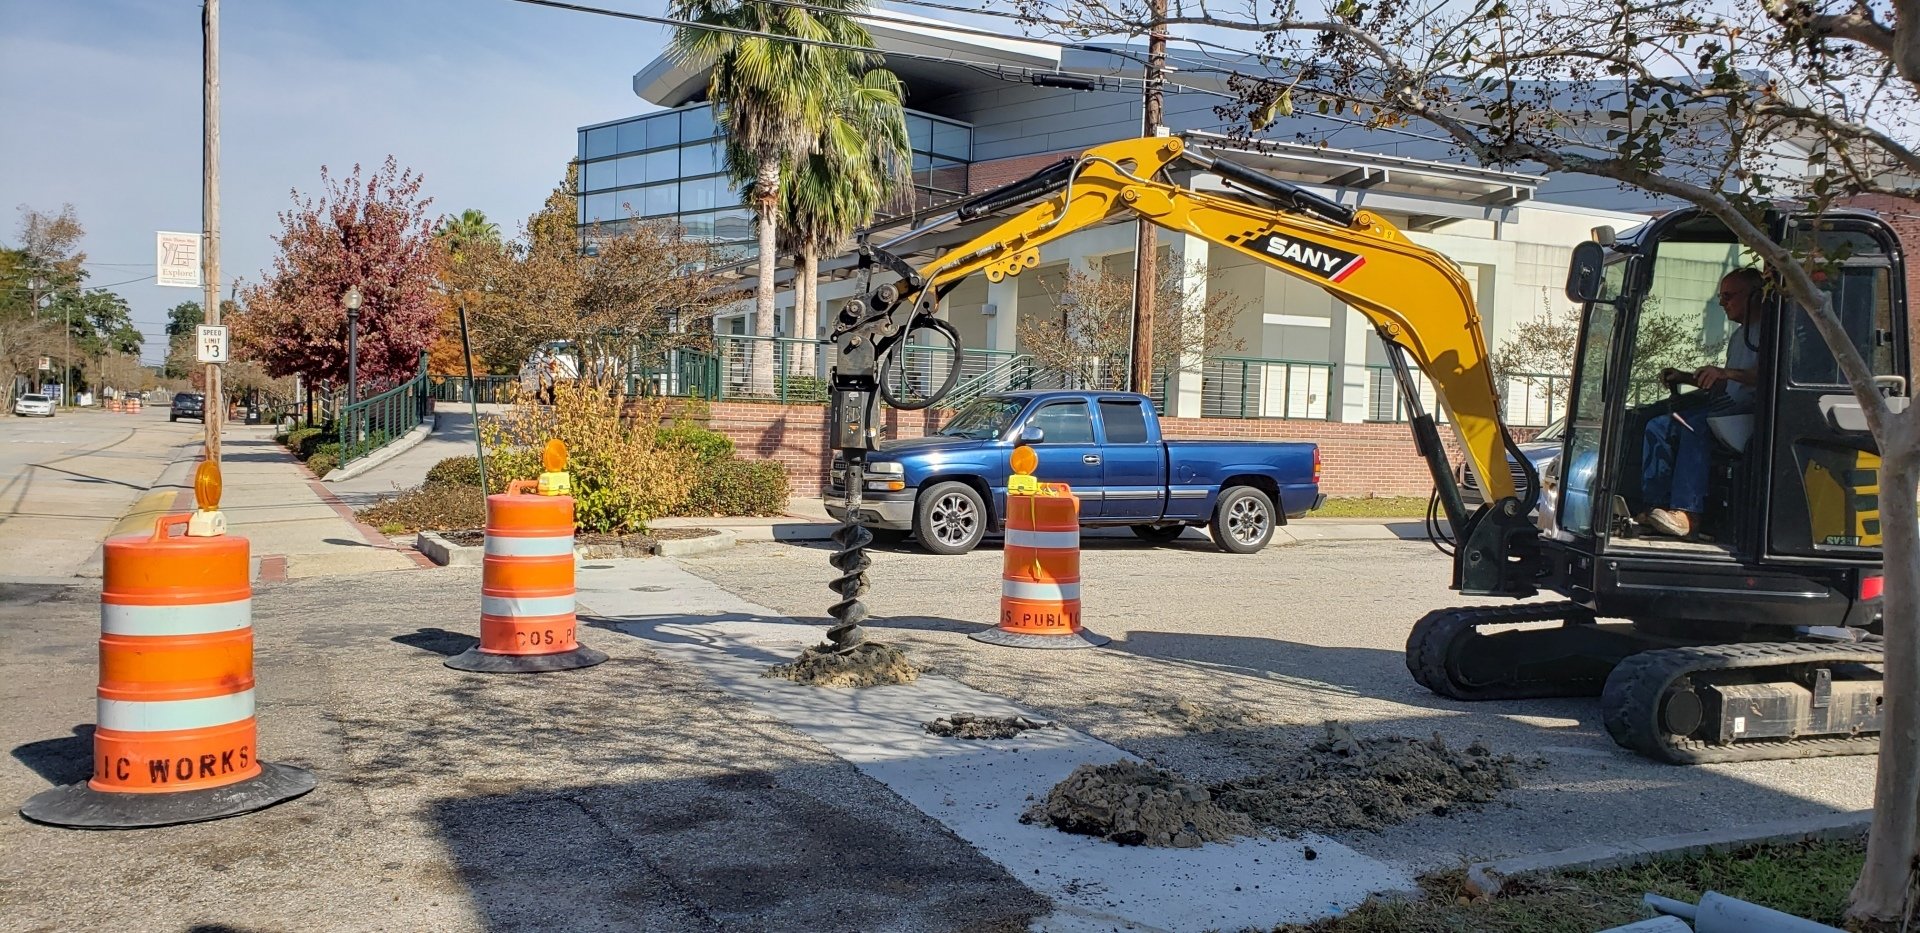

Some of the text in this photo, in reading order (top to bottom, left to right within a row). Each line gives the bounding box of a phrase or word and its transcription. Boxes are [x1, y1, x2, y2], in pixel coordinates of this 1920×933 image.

[1266, 236, 1342, 272] SANY
[162, 268, 197, 278] Explore!
[205, 345, 220, 358] 13
[148, 745, 249, 784] WORKS
